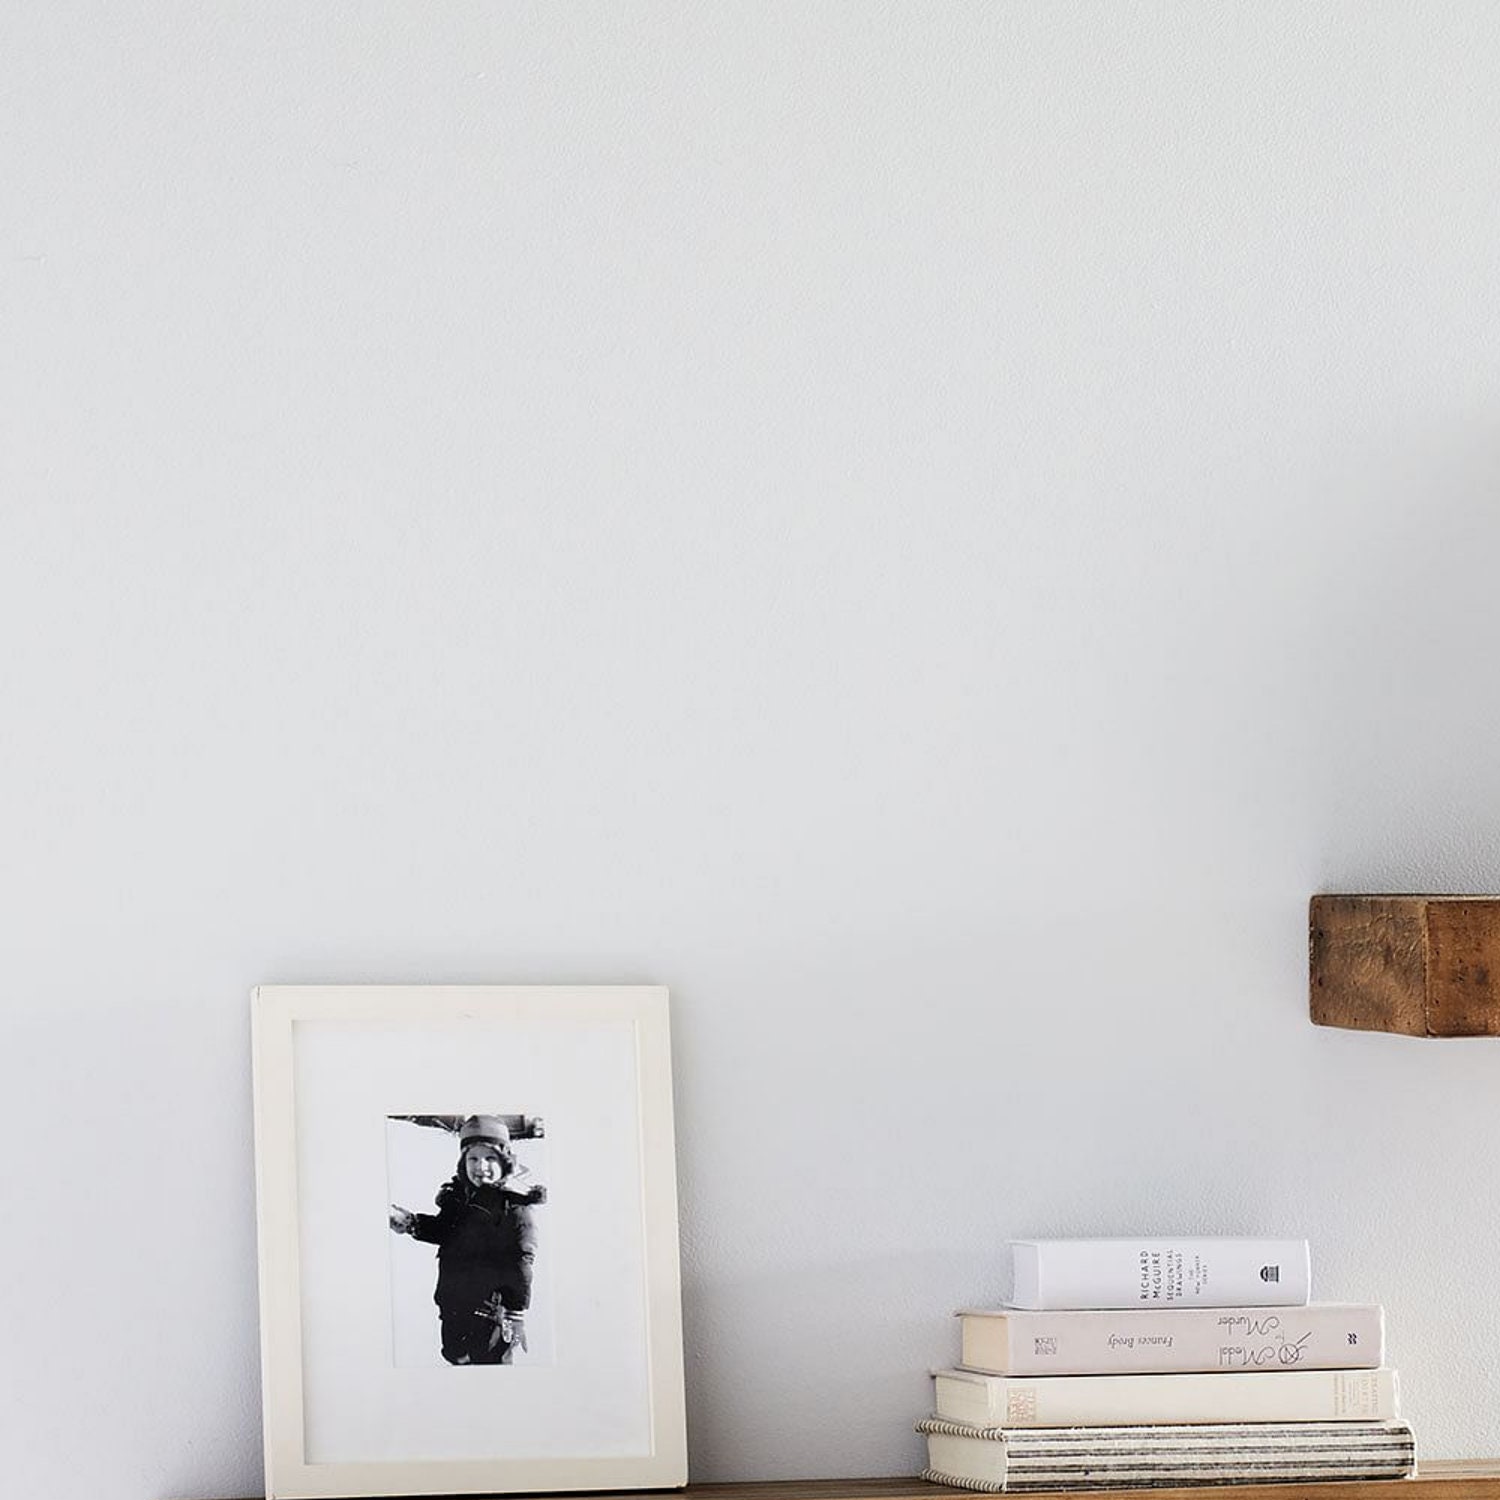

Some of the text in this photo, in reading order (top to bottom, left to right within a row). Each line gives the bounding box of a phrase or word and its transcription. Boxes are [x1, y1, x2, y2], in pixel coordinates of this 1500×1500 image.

[1139, 1250, 1149, 1299] RICHARD
[1175, 1252, 1183, 1297] DRAWINGS
[1217, 1315, 1281, 1336] Murder
[1107, 1333, 1174, 1350] Frances Brody
[1219, 1346, 1276, 1366] Medal
